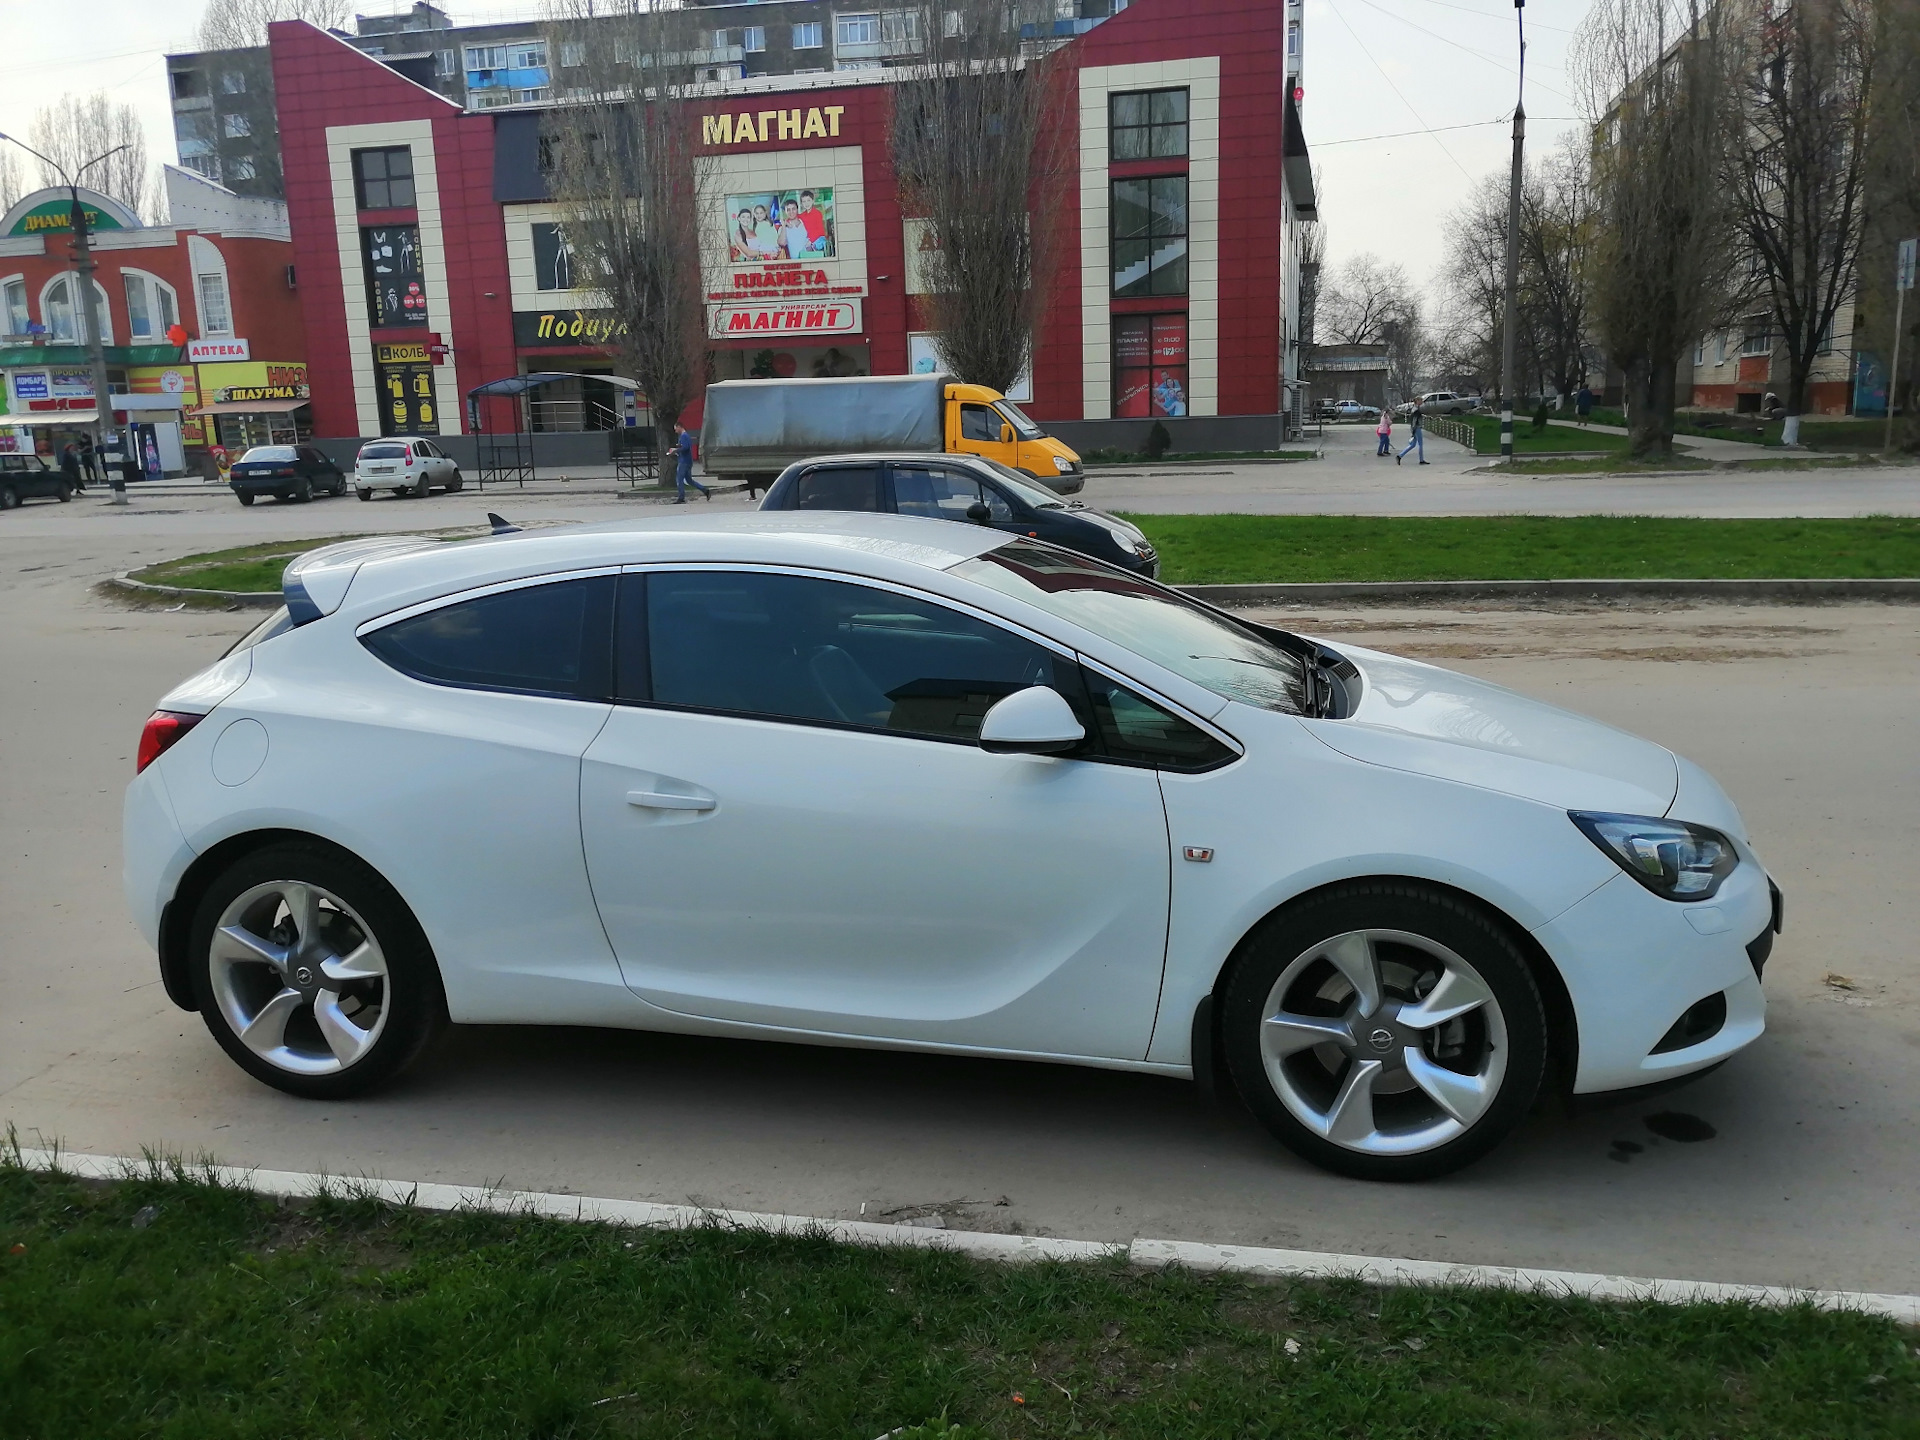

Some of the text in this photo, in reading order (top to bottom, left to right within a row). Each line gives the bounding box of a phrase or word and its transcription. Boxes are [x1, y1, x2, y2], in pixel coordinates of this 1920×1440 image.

[702, 105, 845, 145] МАГНАТ
[24, 211, 98, 232] ДИАМТ
[733, 269, 829, 289] ПЛАНЕТА
[728, 309, 841, 331] МАГНИТ
[192, 345, 245, 356] АПТЕКА
[392, 347, 427, 359] КОЛБ
[16, 376, 46, 386] ЛОМБАРД
[231, 386, 295, 401] ШАУРМА
